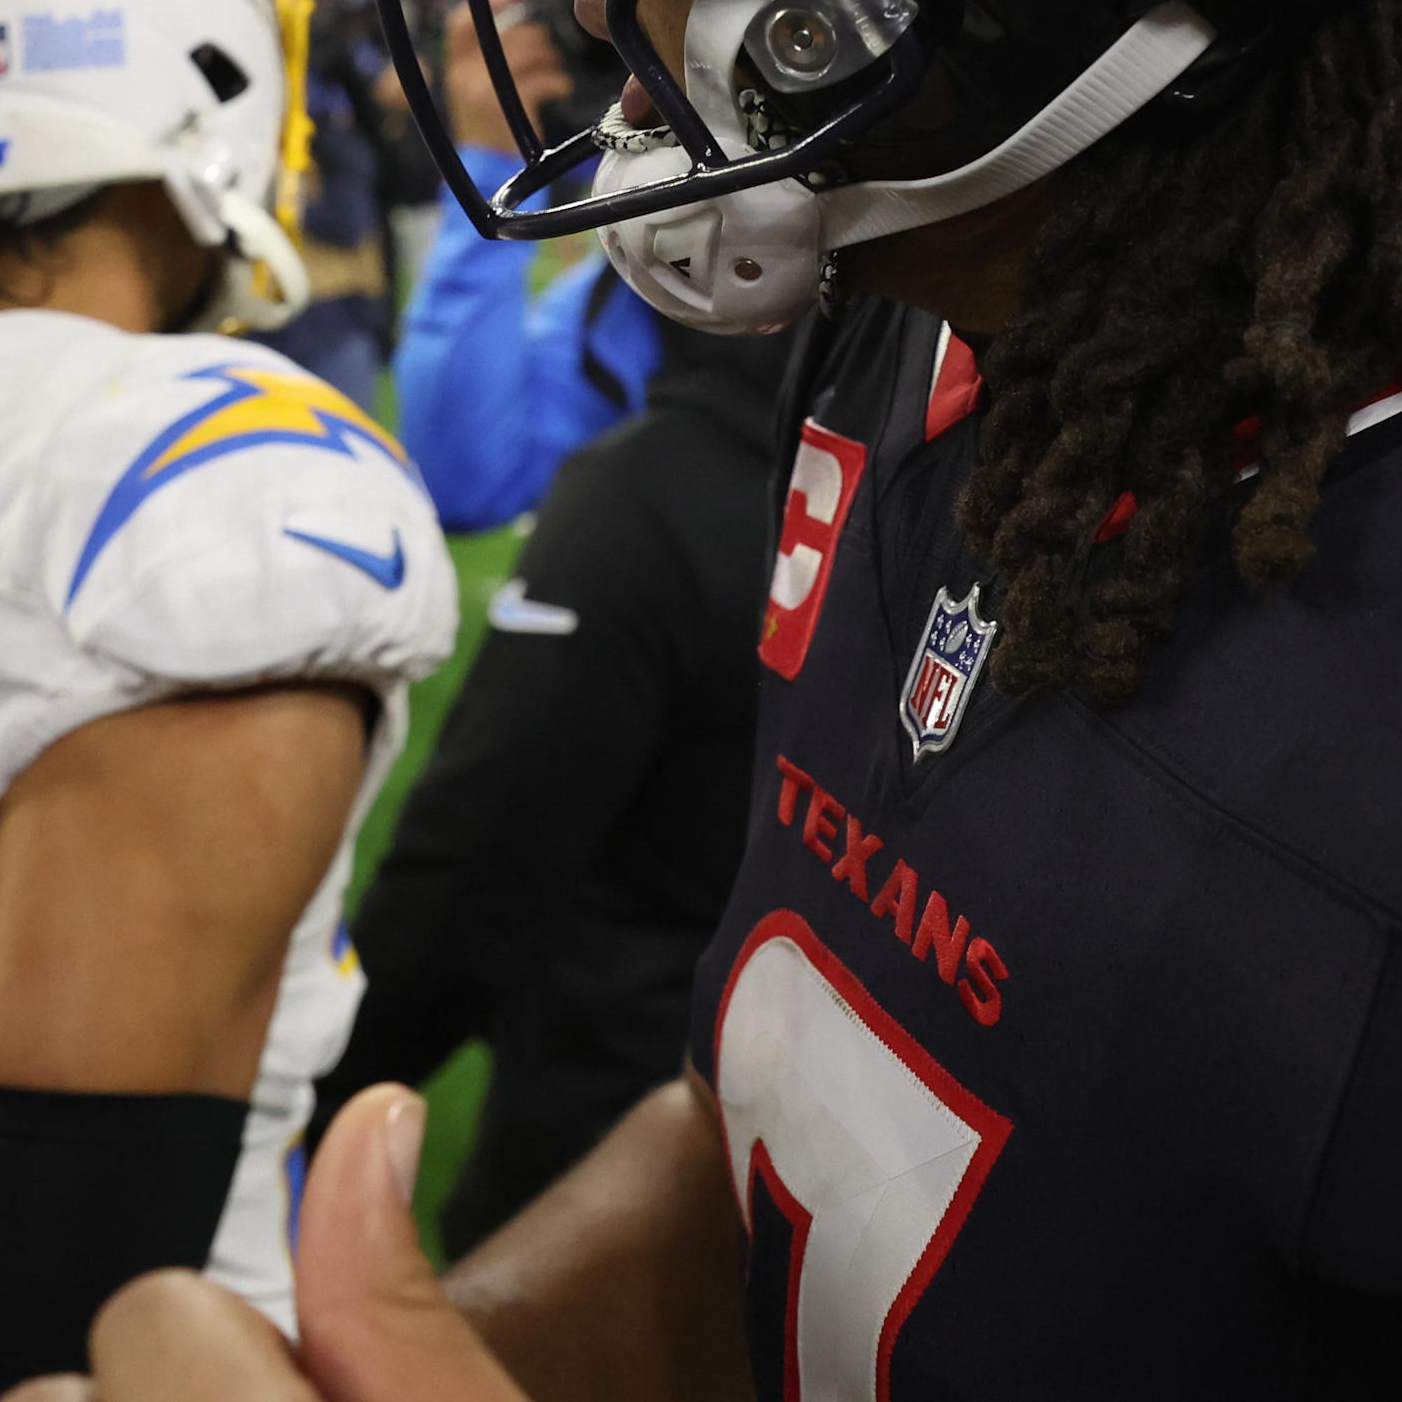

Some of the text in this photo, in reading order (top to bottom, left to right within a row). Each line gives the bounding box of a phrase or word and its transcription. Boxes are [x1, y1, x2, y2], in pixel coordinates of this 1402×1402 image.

[910, 654, 961, 730] NFL
[776, 753, 1010, 1027] TEXANS
[713, 909, 1014, 1402] 7
